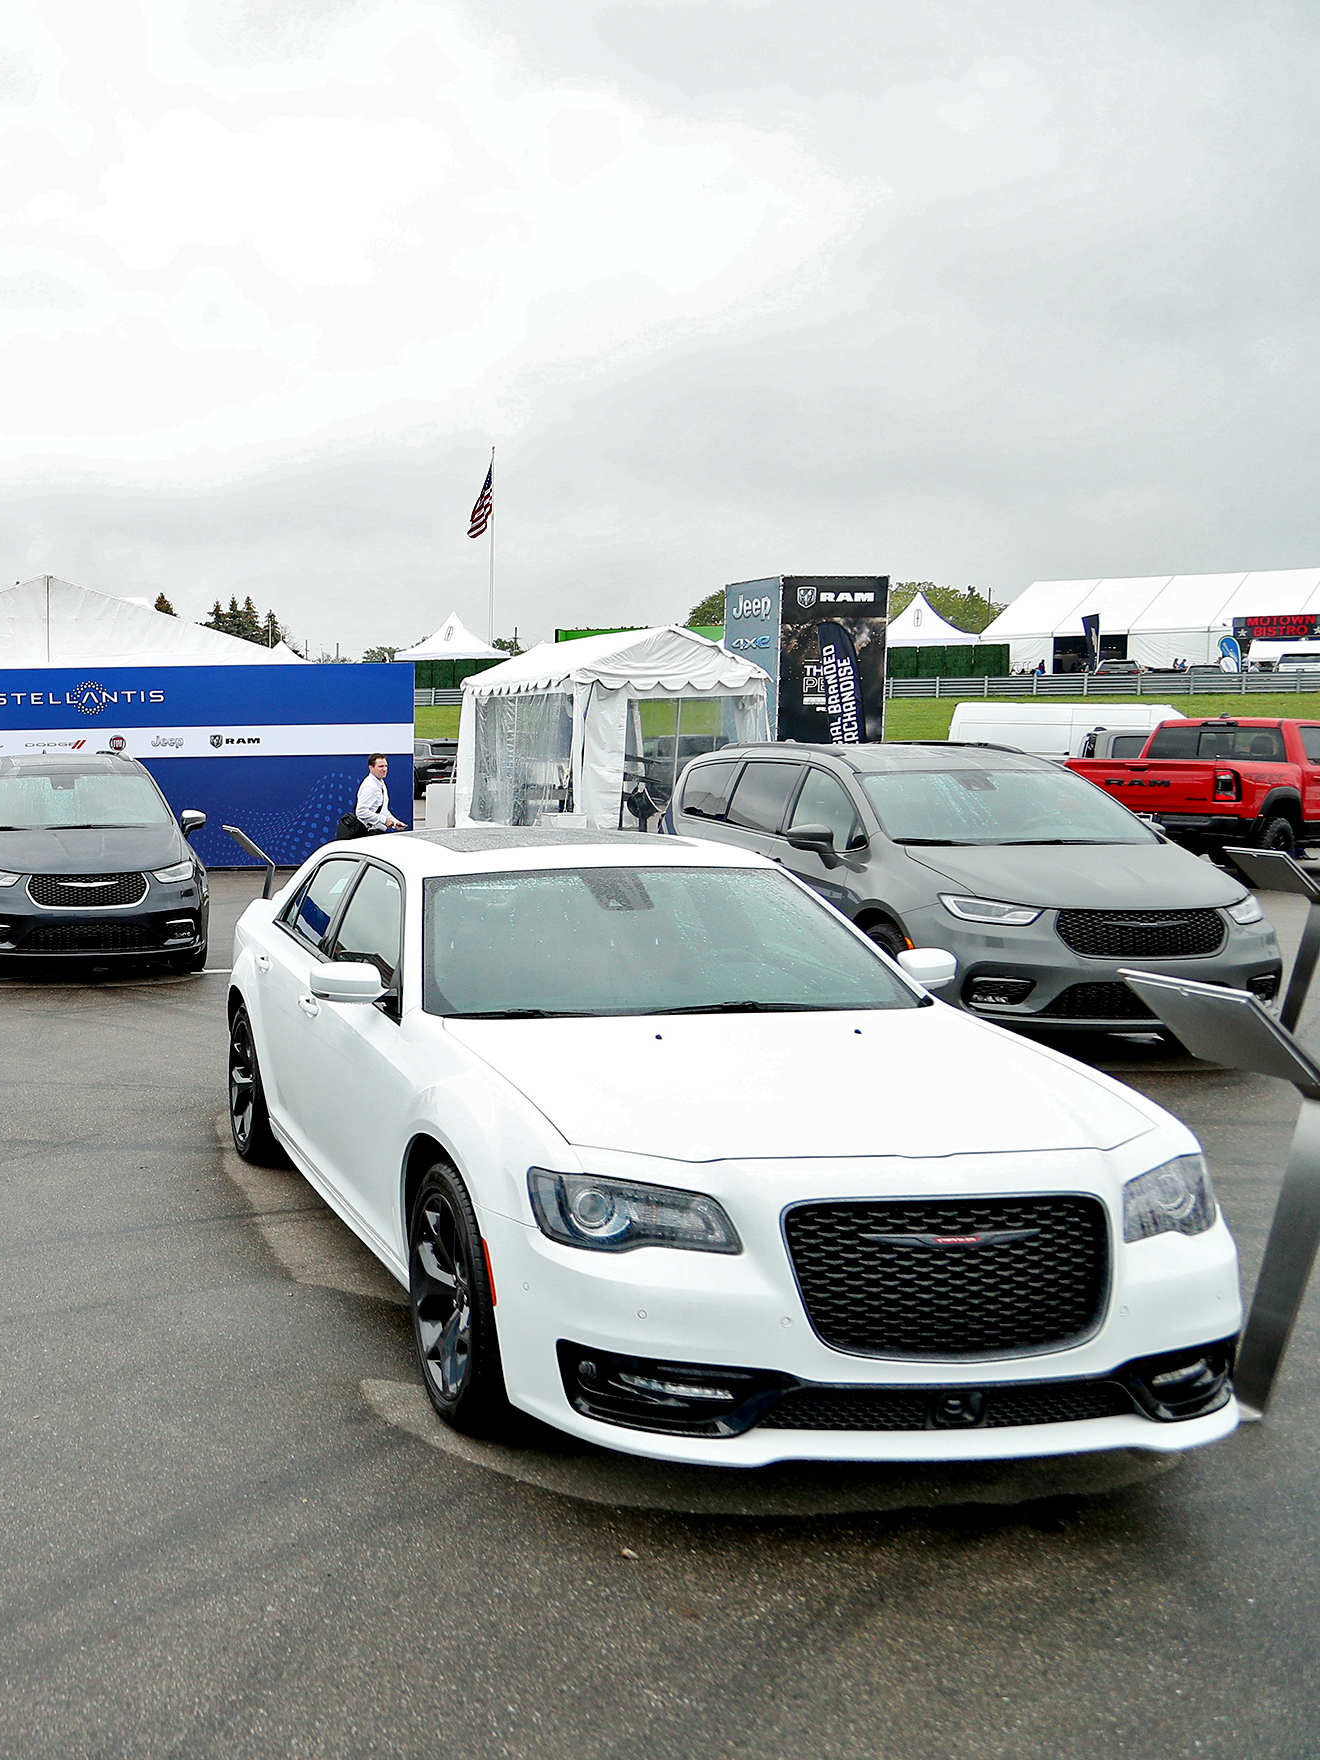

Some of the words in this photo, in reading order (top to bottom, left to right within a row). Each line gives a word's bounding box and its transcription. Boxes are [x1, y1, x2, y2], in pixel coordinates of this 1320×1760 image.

[819, 591, 875, 603] RAM
[732, 594, 771, 620] Jeep
[1246, 615, 1317, 627] MOTOWN
[1253, 625, 1309, 637] BISTRO
[822, 644, 842, 714] BRANDED
[829, 716, 843, 744] IAL
[151, 735, 184, 749] Jeep
[225, 737, 261, 745] RAM
[1104, 778, 1171, 788] RAM
